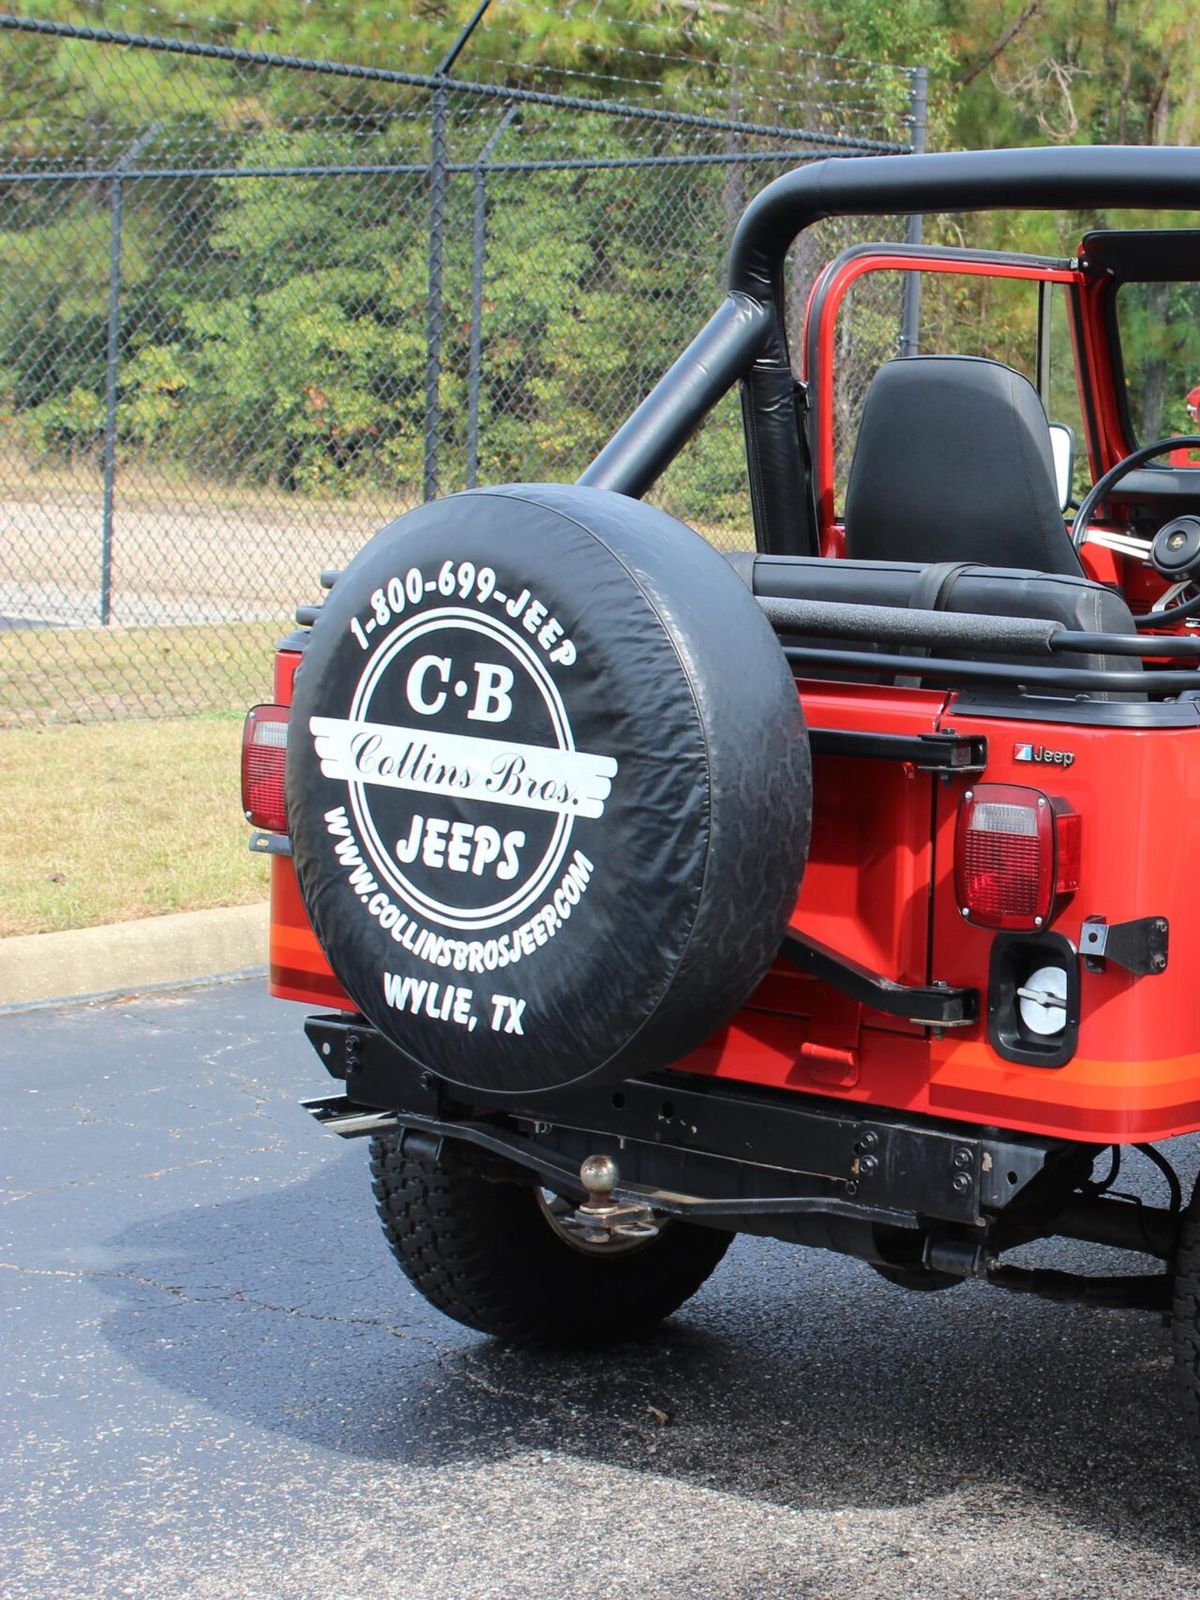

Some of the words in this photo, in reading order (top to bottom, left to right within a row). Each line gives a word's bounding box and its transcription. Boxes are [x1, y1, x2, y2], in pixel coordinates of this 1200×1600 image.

[350, 560, 578, 667] 1-800-699-JEEP
[350, 732, 472, 789] Collins
[485, 752, 580, 806] Bros.
[1034, 745, 1076, 768] Jeep
[396, 814, 526, 880] JEEPS
[324, 806, 595, 974] WWW.COLLINSBROSJEEP.COM
[383, 972, 478, 1032] WYLIE,
[491, 994, 527, 1035] TX
